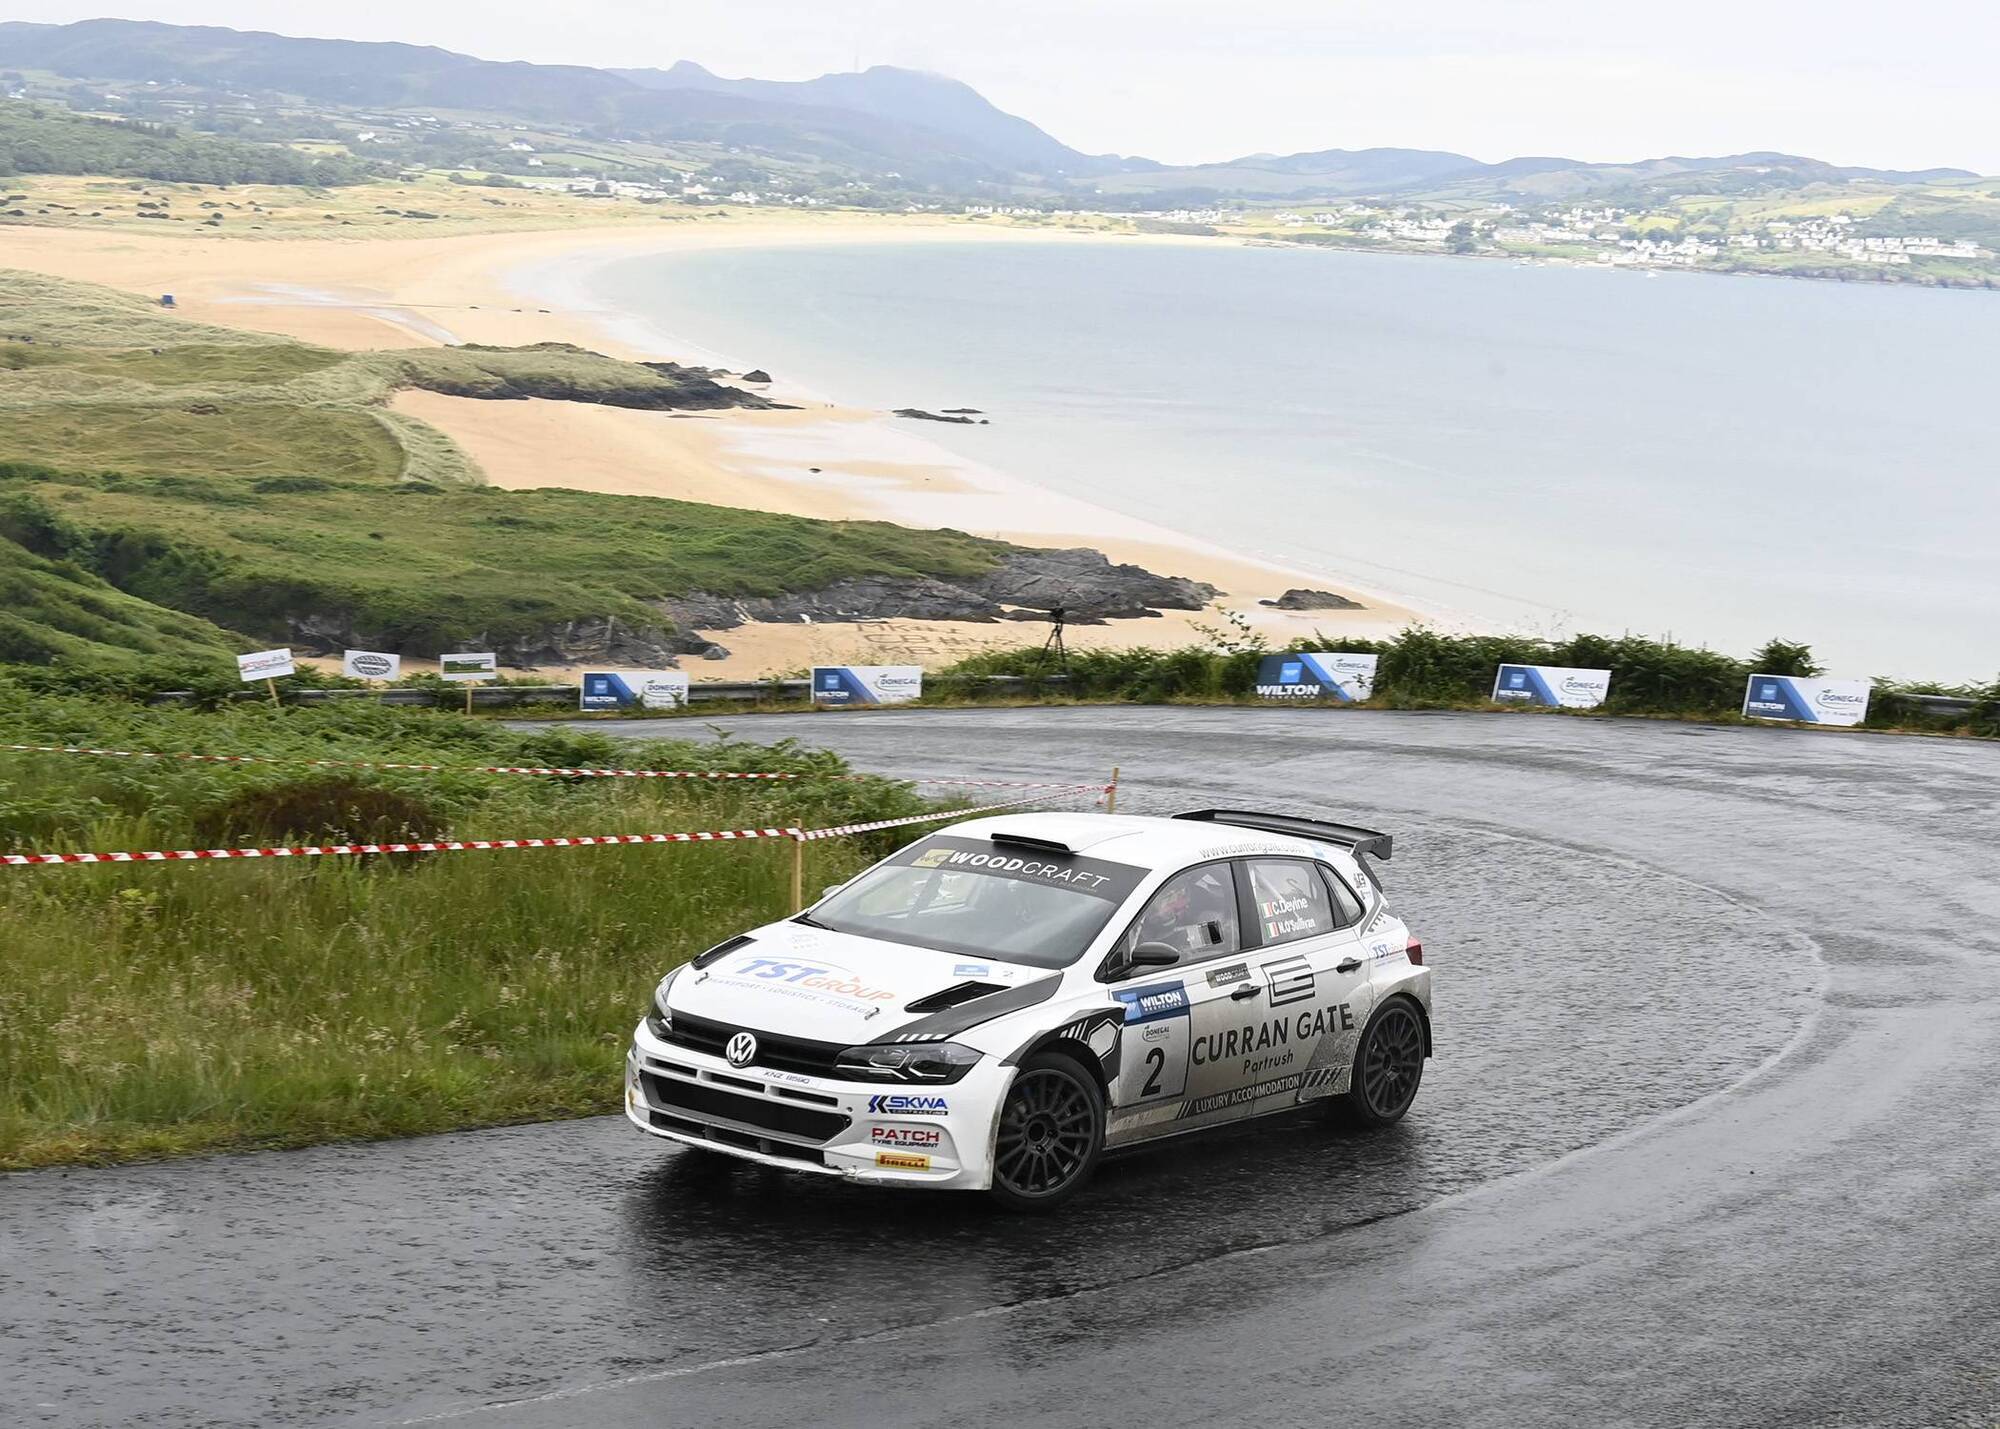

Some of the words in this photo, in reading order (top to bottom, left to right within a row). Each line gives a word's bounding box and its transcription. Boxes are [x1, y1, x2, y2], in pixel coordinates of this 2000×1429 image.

[1256, 684, 1321, 696] WILTON
[949, 851, 1111, 888] WOODCRAFT
[1372, 943, 1389, 960] TST
[1140, 991, 1182, 1009] WILTON
[1192, 1016, 1289, 1066] CURRAN
[1296, 1002, 1355, 1040] GATE
[1242, 1048, 1294, 1076] Portrush
[1140, 1046, 1166, 1098] 2
[885, 1095, 948, 1110] SKWA
[1195, 1093, 1230, 1114] LUXURY
[1230, 1075, 1300, 1104] ACCOMMODATION
[871, 1127, 940, 1142] PATCH
[879, 1154, 926, 1168] PIRELLI
